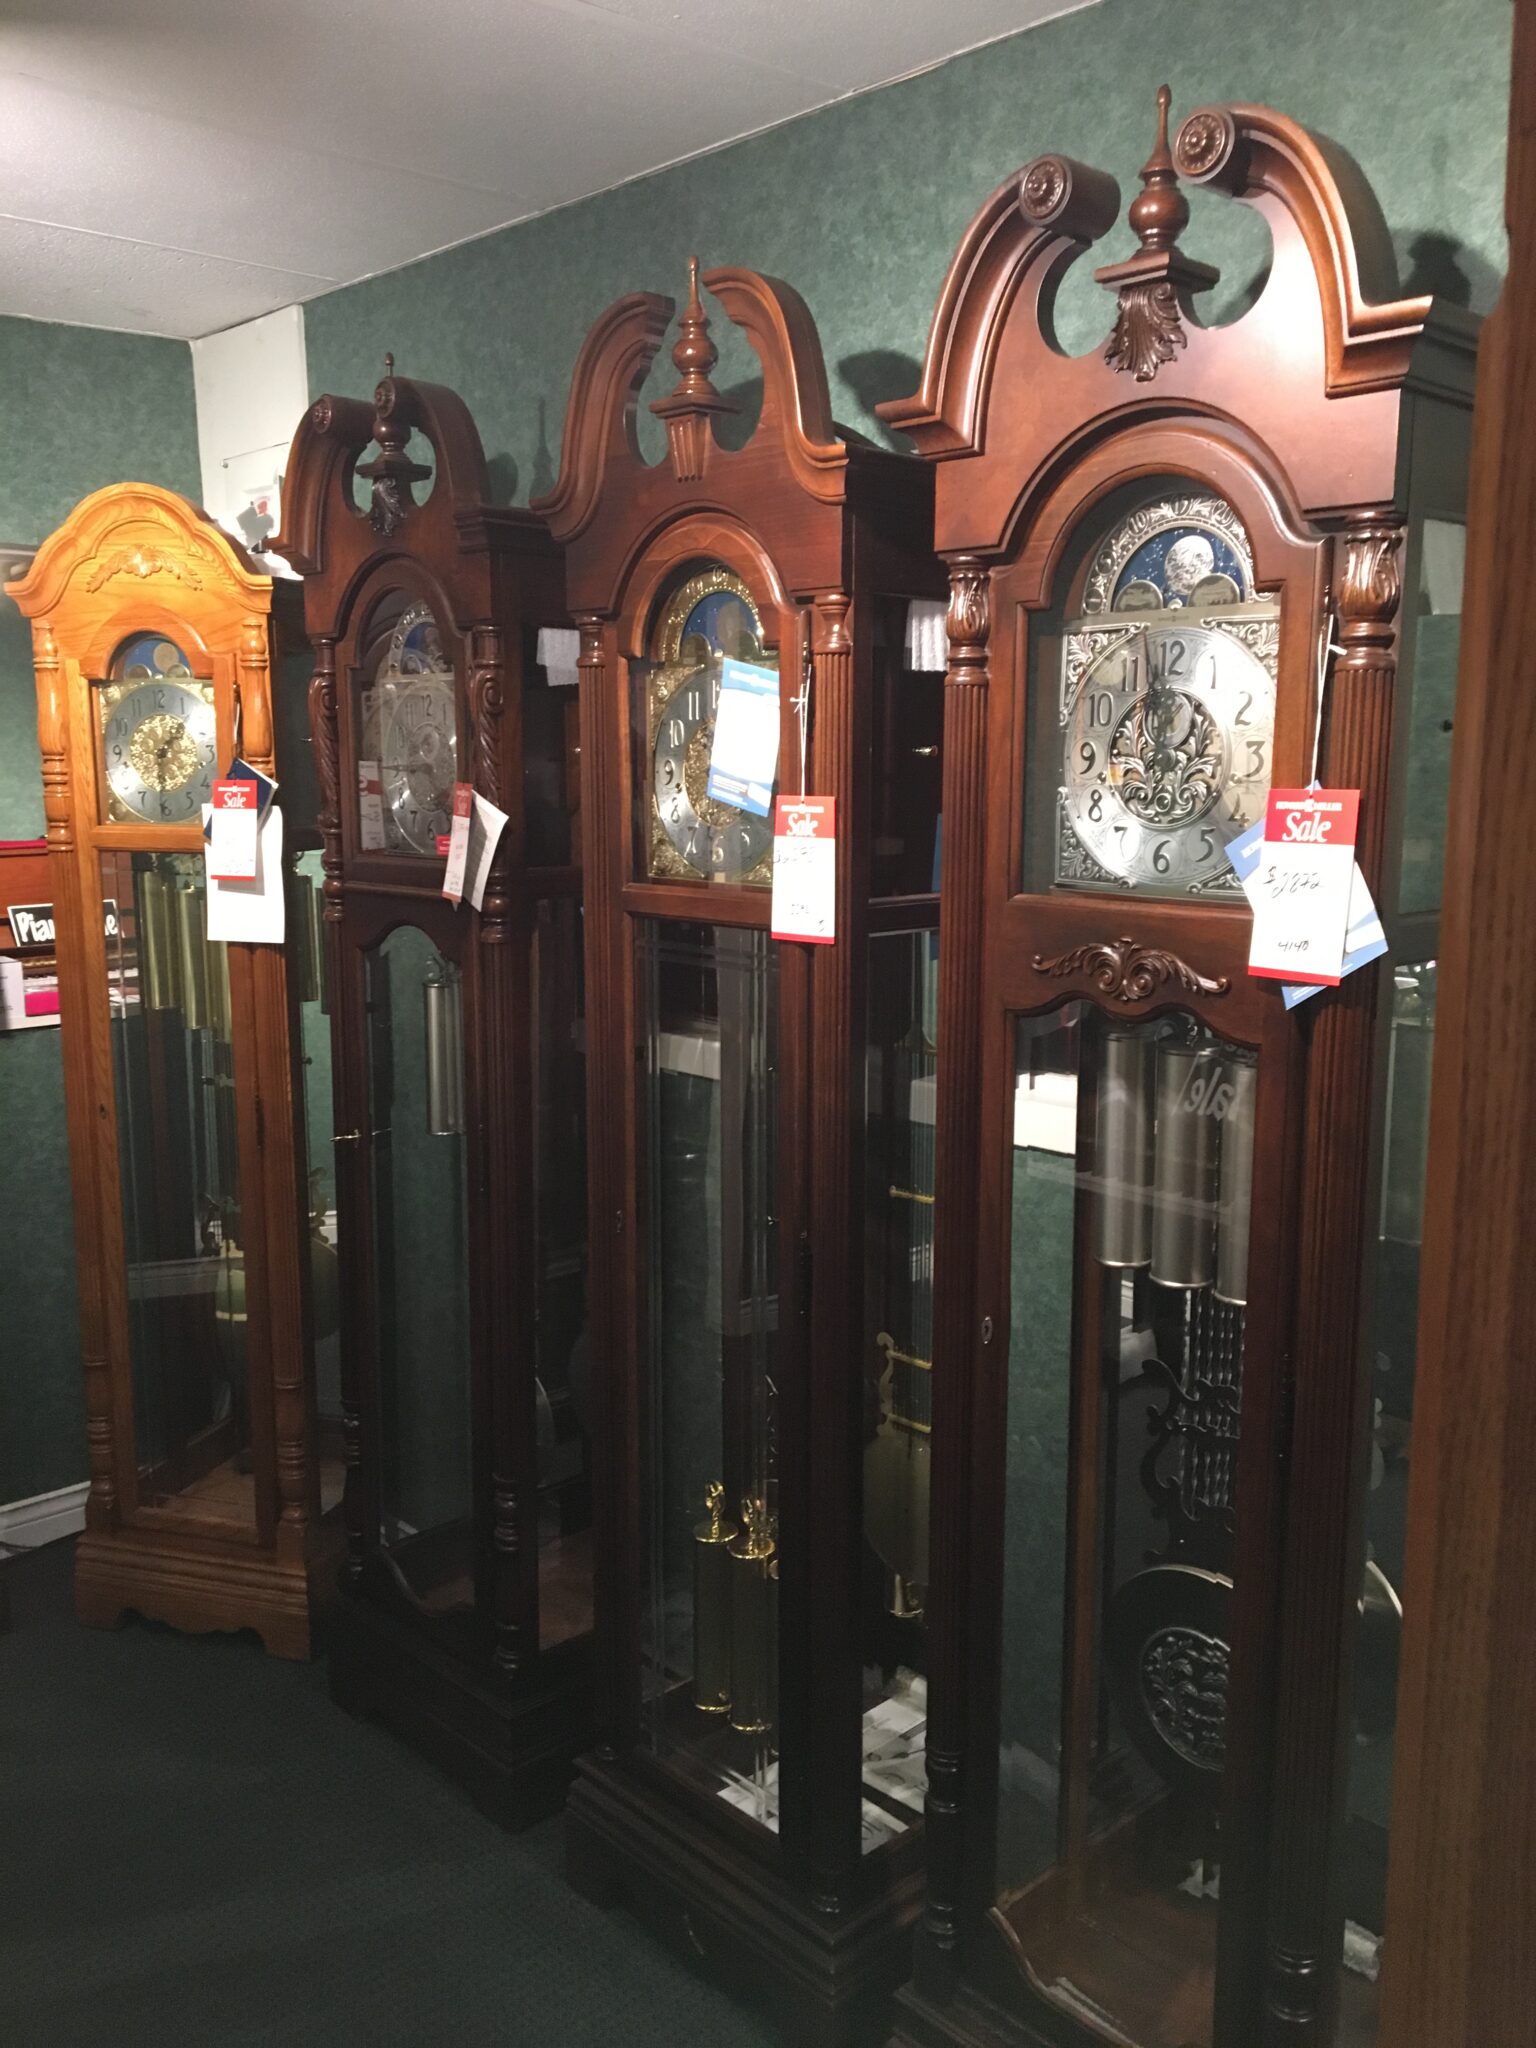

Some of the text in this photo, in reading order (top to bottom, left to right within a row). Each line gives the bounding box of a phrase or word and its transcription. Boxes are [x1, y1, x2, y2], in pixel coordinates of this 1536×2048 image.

[1130, 511, 1147, 535] 10
[1160, 639, 1186, 676] 12
[1209, 655, 1218, 689] 1
[1121, 655, 1141, 692] 11
[131, 698, 142, 718] 11
[152, 689, 166, 710] 12
[421, 693, 433, 717] 12
[688, 691, 700, 720] 11
[1088, 691, 1114, 727] 10
[1235, 691, 1254, 725] 2
[114, 717, 129, 737] 10
[669, 719, 685, 749] 10
[112, 744, 123, 764] 9
[205, 744, 216, 764] 3
[1080, 741, 1097, 775] 9
[1244, 740, 1266, 778] 3
[200, 773, 212, 790] 4
[663, 758, 676, 786] 9
[137, 791, 147, 809] 7
[184, 791, 195, 810] 5
[222, 791, 247, 808] Sale
[670, 796, 681, 824] 8
[1088, 788, 1103, 822] 8
[1228, 793, 1250, 828] 4
[409, 810, 419, 833] 7
[427, 819, 435, 841] 6
[786, 812, 820, 838] Sale
[1281, 811, 1333, 842] Sale
[683, 824, 700, 858] 7
[712, 834, 725, 864] 6
[1113, 825, 1129, 857] 7
[1196, 826, 1217, 862] 5
[1152, 839, 1171, 874] 6
